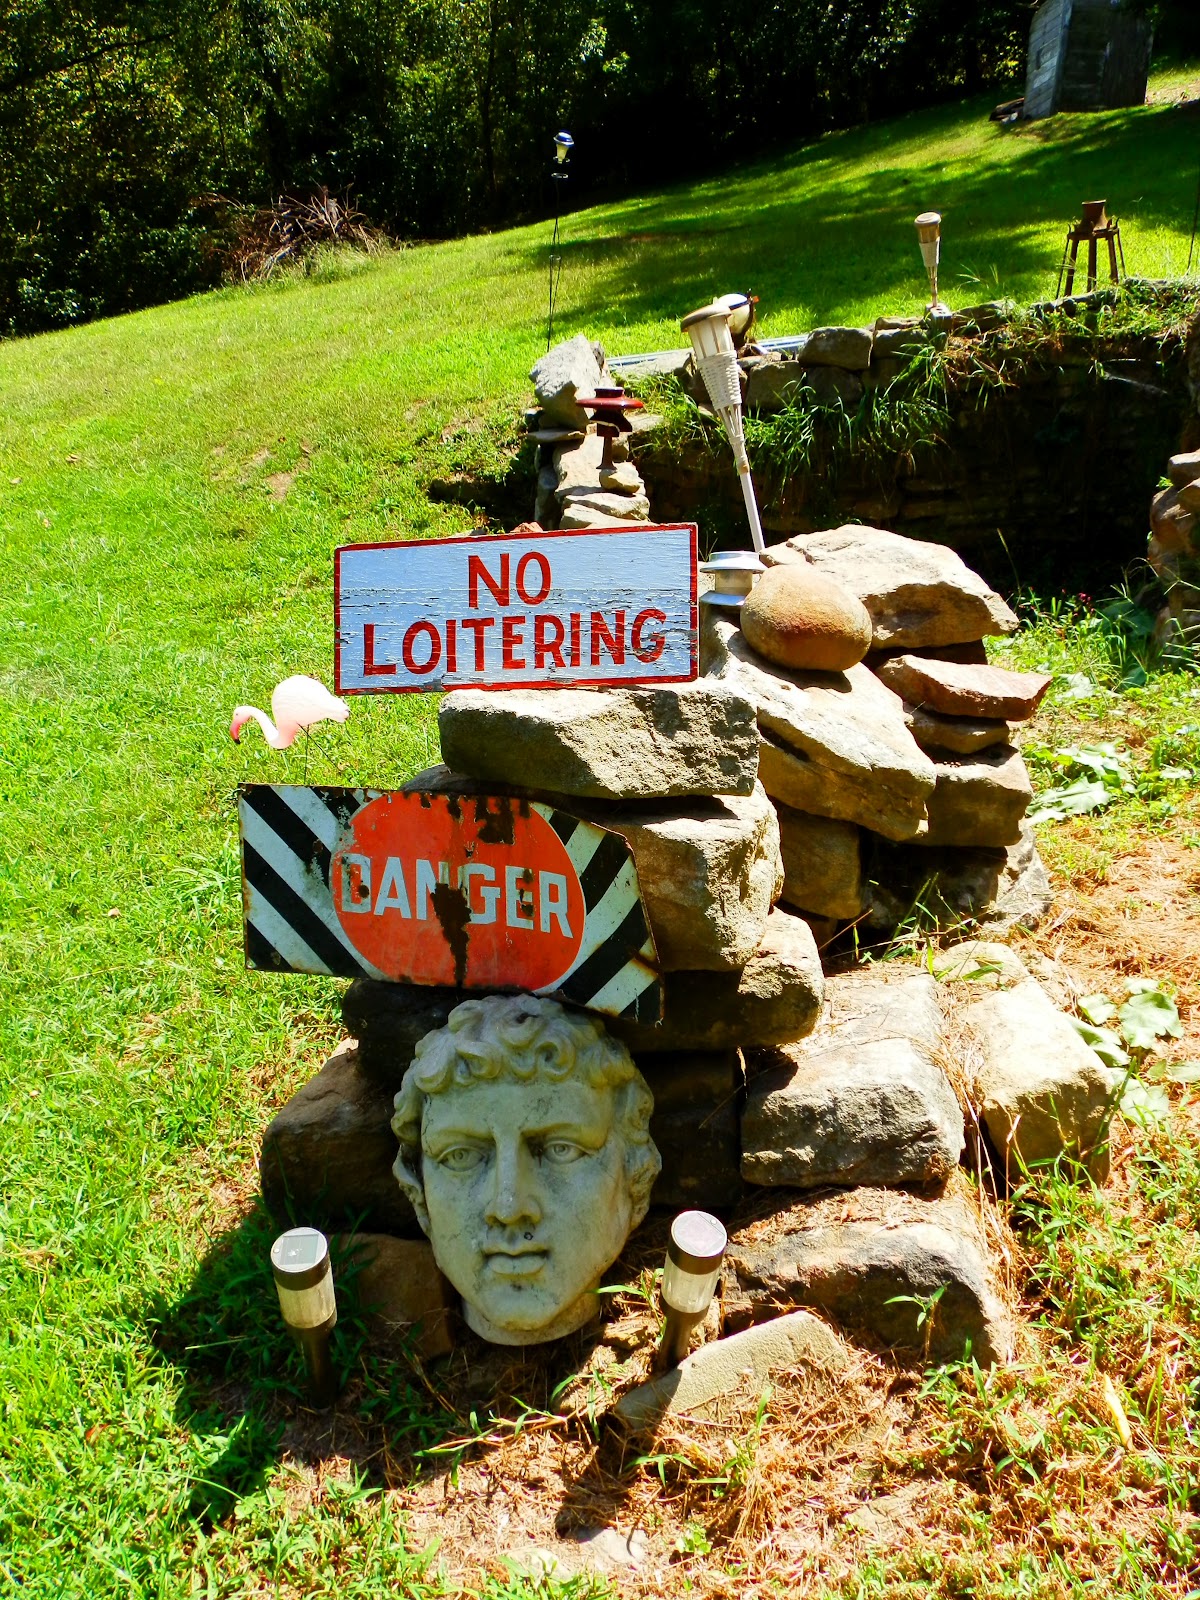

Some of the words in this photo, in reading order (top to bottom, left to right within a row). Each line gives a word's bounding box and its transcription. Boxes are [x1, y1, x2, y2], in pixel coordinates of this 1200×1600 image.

[468, 551, 552, 608] NO
[363, 608, 667, 676] LOITERING
[340, 853, 574, 939] DANGER
